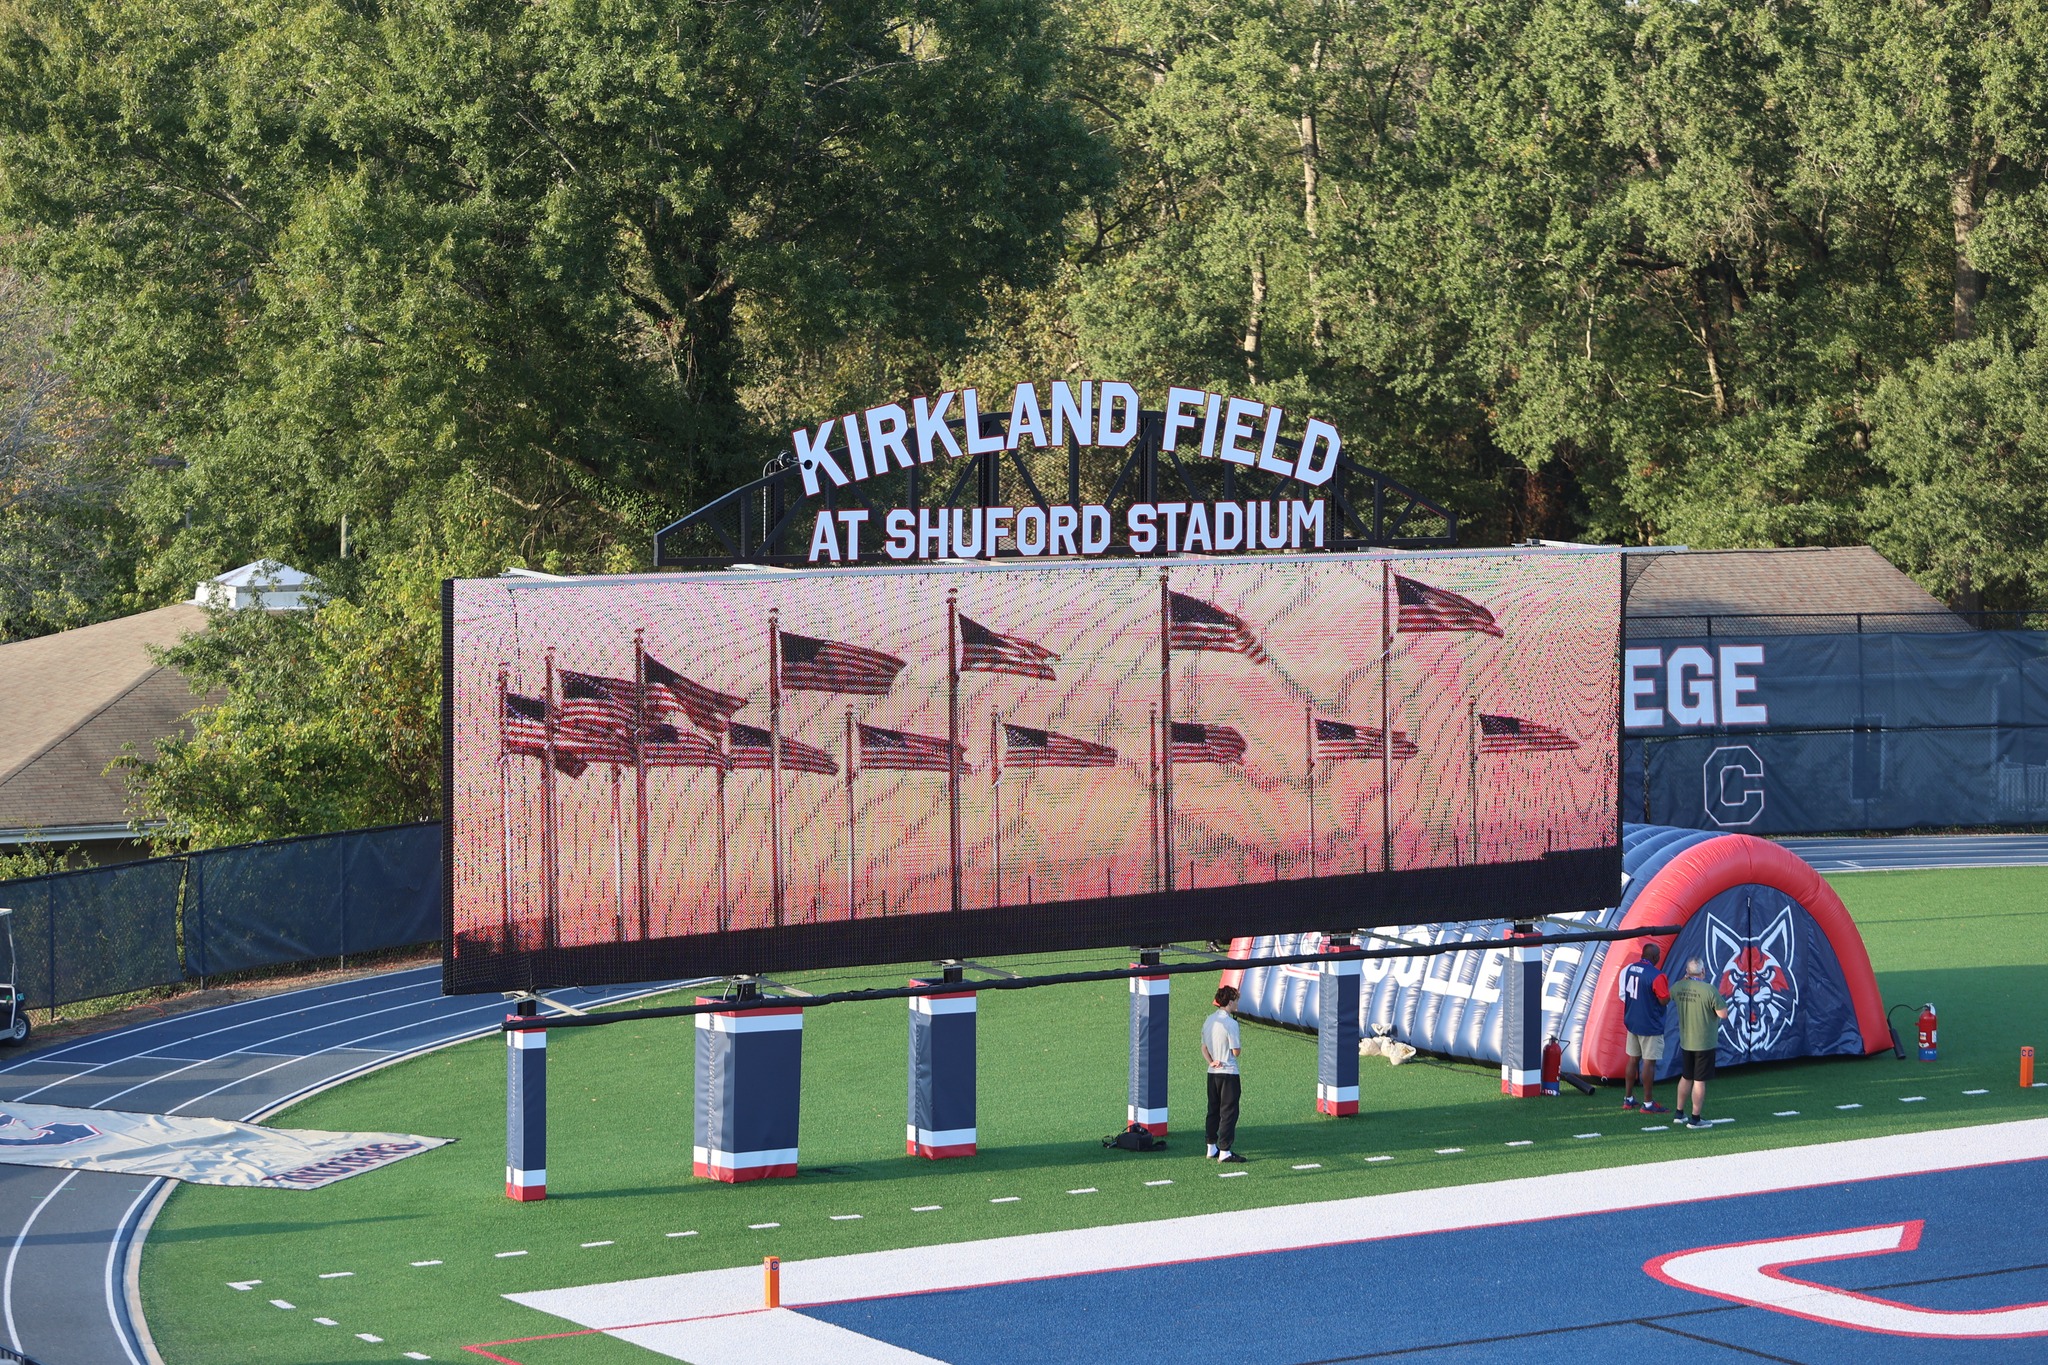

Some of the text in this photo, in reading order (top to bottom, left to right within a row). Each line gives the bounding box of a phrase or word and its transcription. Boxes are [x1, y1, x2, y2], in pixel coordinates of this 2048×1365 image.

[791, 379, 1342, 497] KIRKLAND FIELD
[808, 499, 1326, 562] AT SHUFORD STADIUM
[1703, 744, 1765, 827] C
[1361, 923, 1584, 1013] COLLEE
[1625, 974, 1640, 1001] 41
